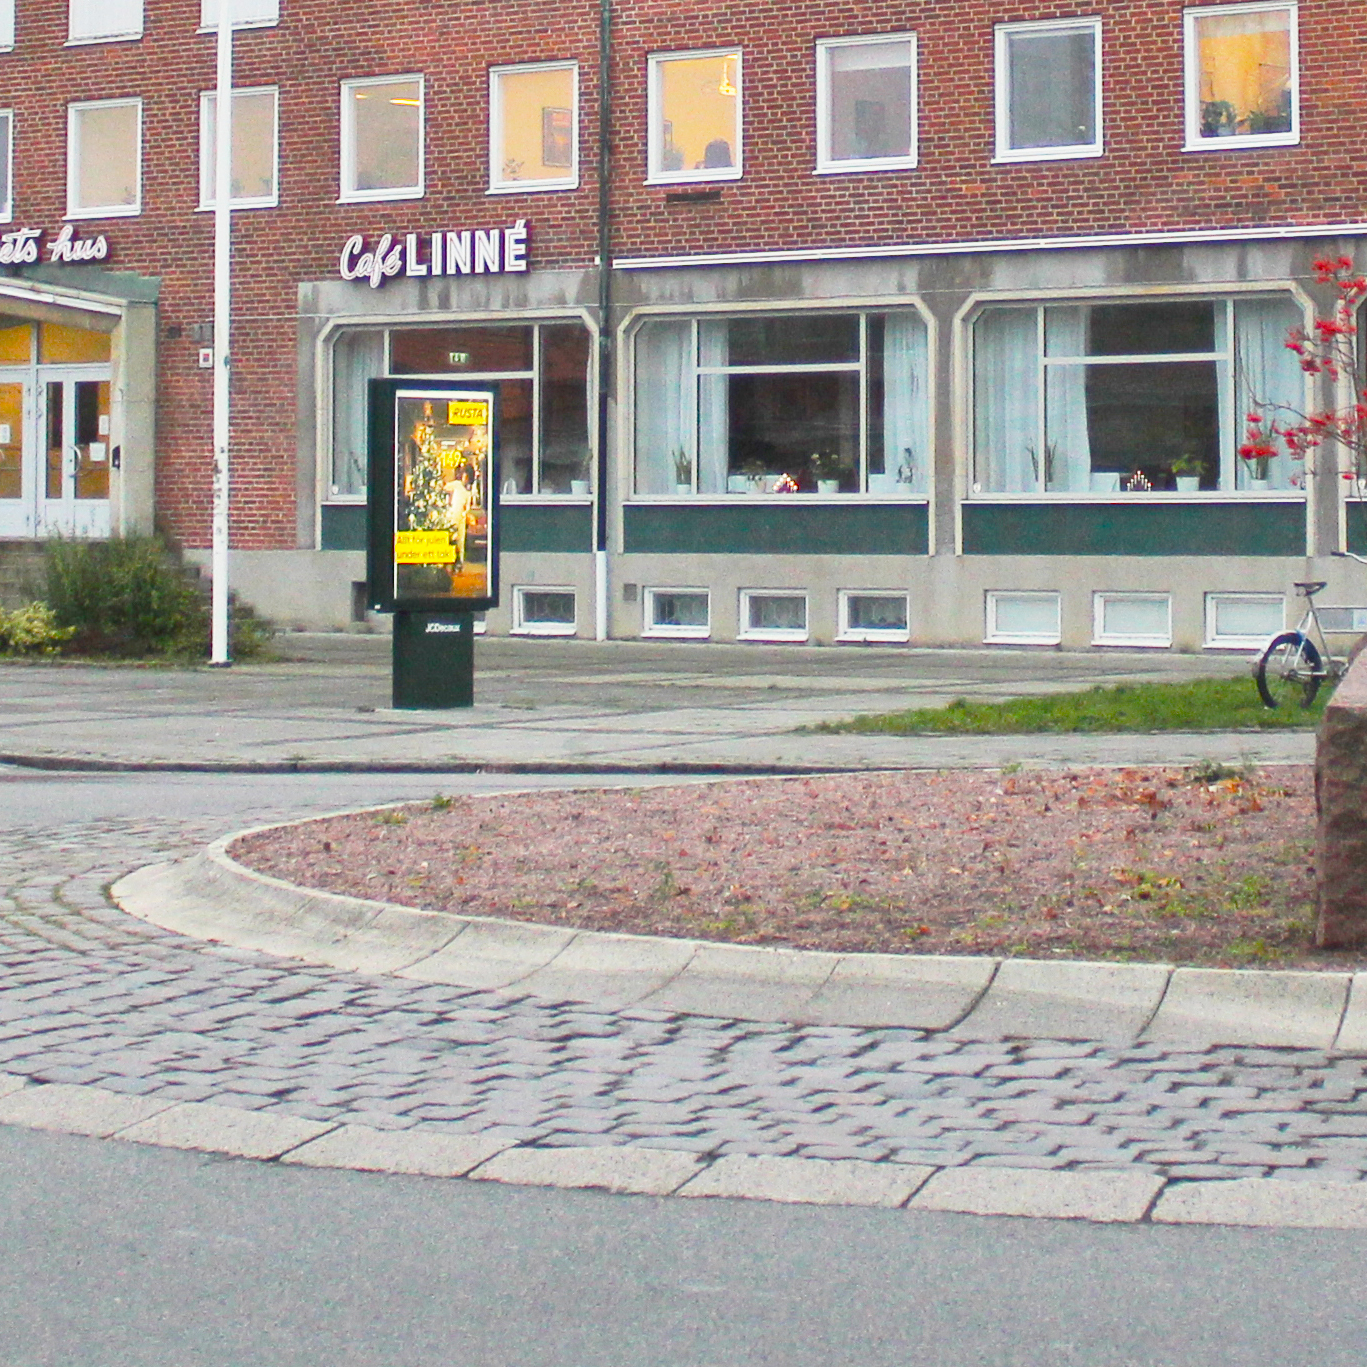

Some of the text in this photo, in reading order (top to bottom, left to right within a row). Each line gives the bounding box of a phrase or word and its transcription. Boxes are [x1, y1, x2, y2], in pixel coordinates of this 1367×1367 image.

[46, 224, 108, 262] hus
[339, 219, 528, 288] Café LINNÉ
[452, 408, 483, 419] RUSTA
[397, 535, 446, 546] Allt för julen
[397, 551, 420, 559] under
[422, 551, 435, 559] ett
